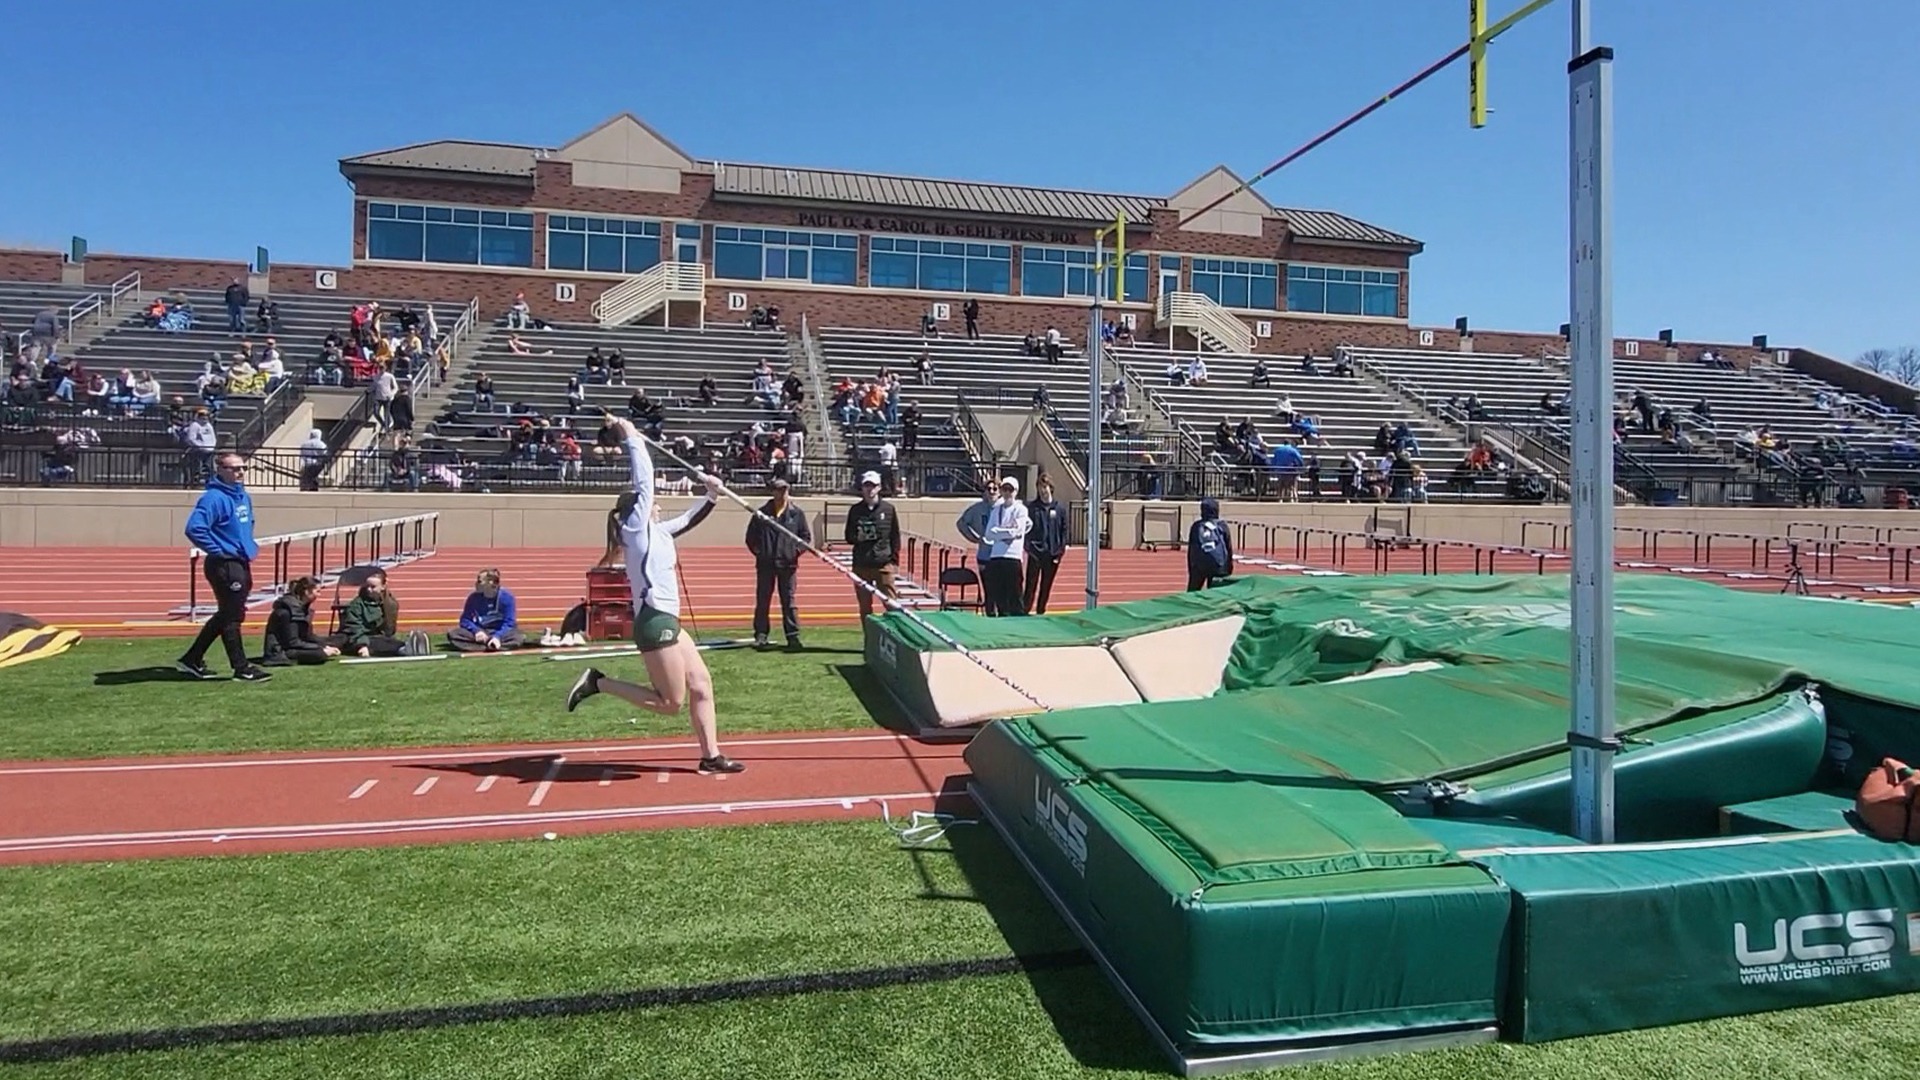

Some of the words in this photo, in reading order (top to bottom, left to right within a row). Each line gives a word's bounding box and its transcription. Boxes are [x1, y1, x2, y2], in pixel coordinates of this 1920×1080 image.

[799, 212, 838, 227] PAUL
[862, 217, 873, 230] &
[879, 219, 929, 233] CAROL
[955, 224, 996, 239] GEHL
[1001, 227, 1045, 241] PRESS
[1050, 231, 1078, 244] BOX
[319, 272, 334, 287] C
[560, 285, 573, 299] D
[732, 295, 745, 308] D
[937, 305, 947, 318] E
[1124, 315, 1134, 327] F
[1260, 323, 1270, 335] F
[1422, 332, 1432, 344] G
[1035, 773, 1088, 862] UCS
[1734, 908, 1895, 966] UCS
[1740, 967, 1767, 975] MADE
[1768, 965, 1778, 973] IN
[1779, 963, 1797, 971] THE
[1740, 959, 1892, 985] WWW.UCSSPIRIT.COM
